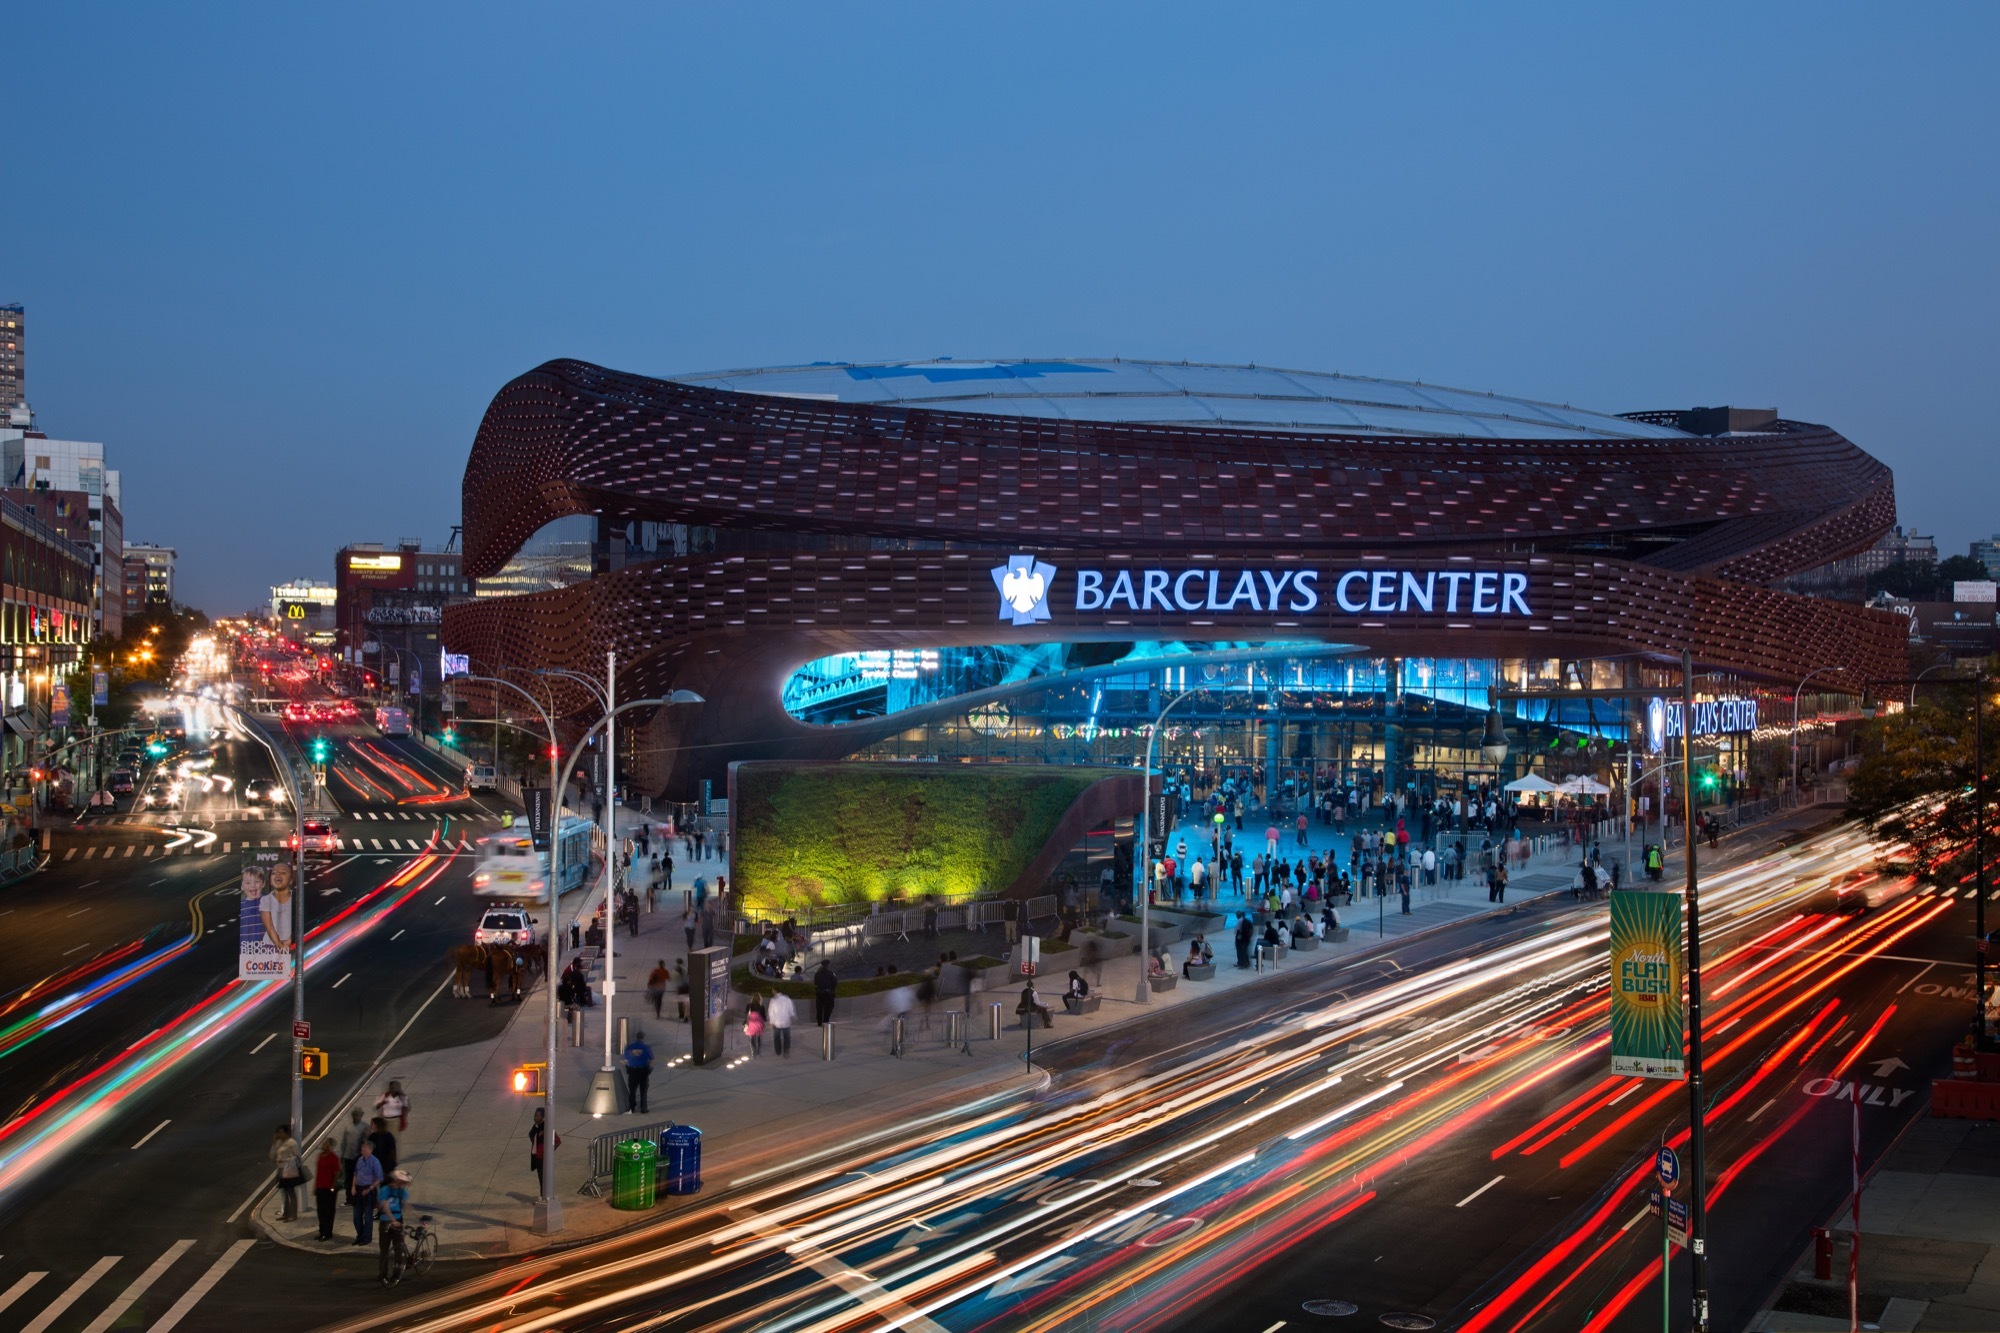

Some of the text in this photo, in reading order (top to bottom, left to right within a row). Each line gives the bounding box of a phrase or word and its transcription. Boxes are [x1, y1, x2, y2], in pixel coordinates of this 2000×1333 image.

[1075, 570, 1533, 616] BARCLAYS CENTER
[1667, 700, 1757, 737] BACLAYS CENTER
[256, 853, 279, 861] NYC
[1626, 949, 1666, 963] North
[1622, 961, 1670, 980] FLAT
[1622, 977, 1670, 994] BUSH
[1802, 1078, 1916, 1107] ONLY
